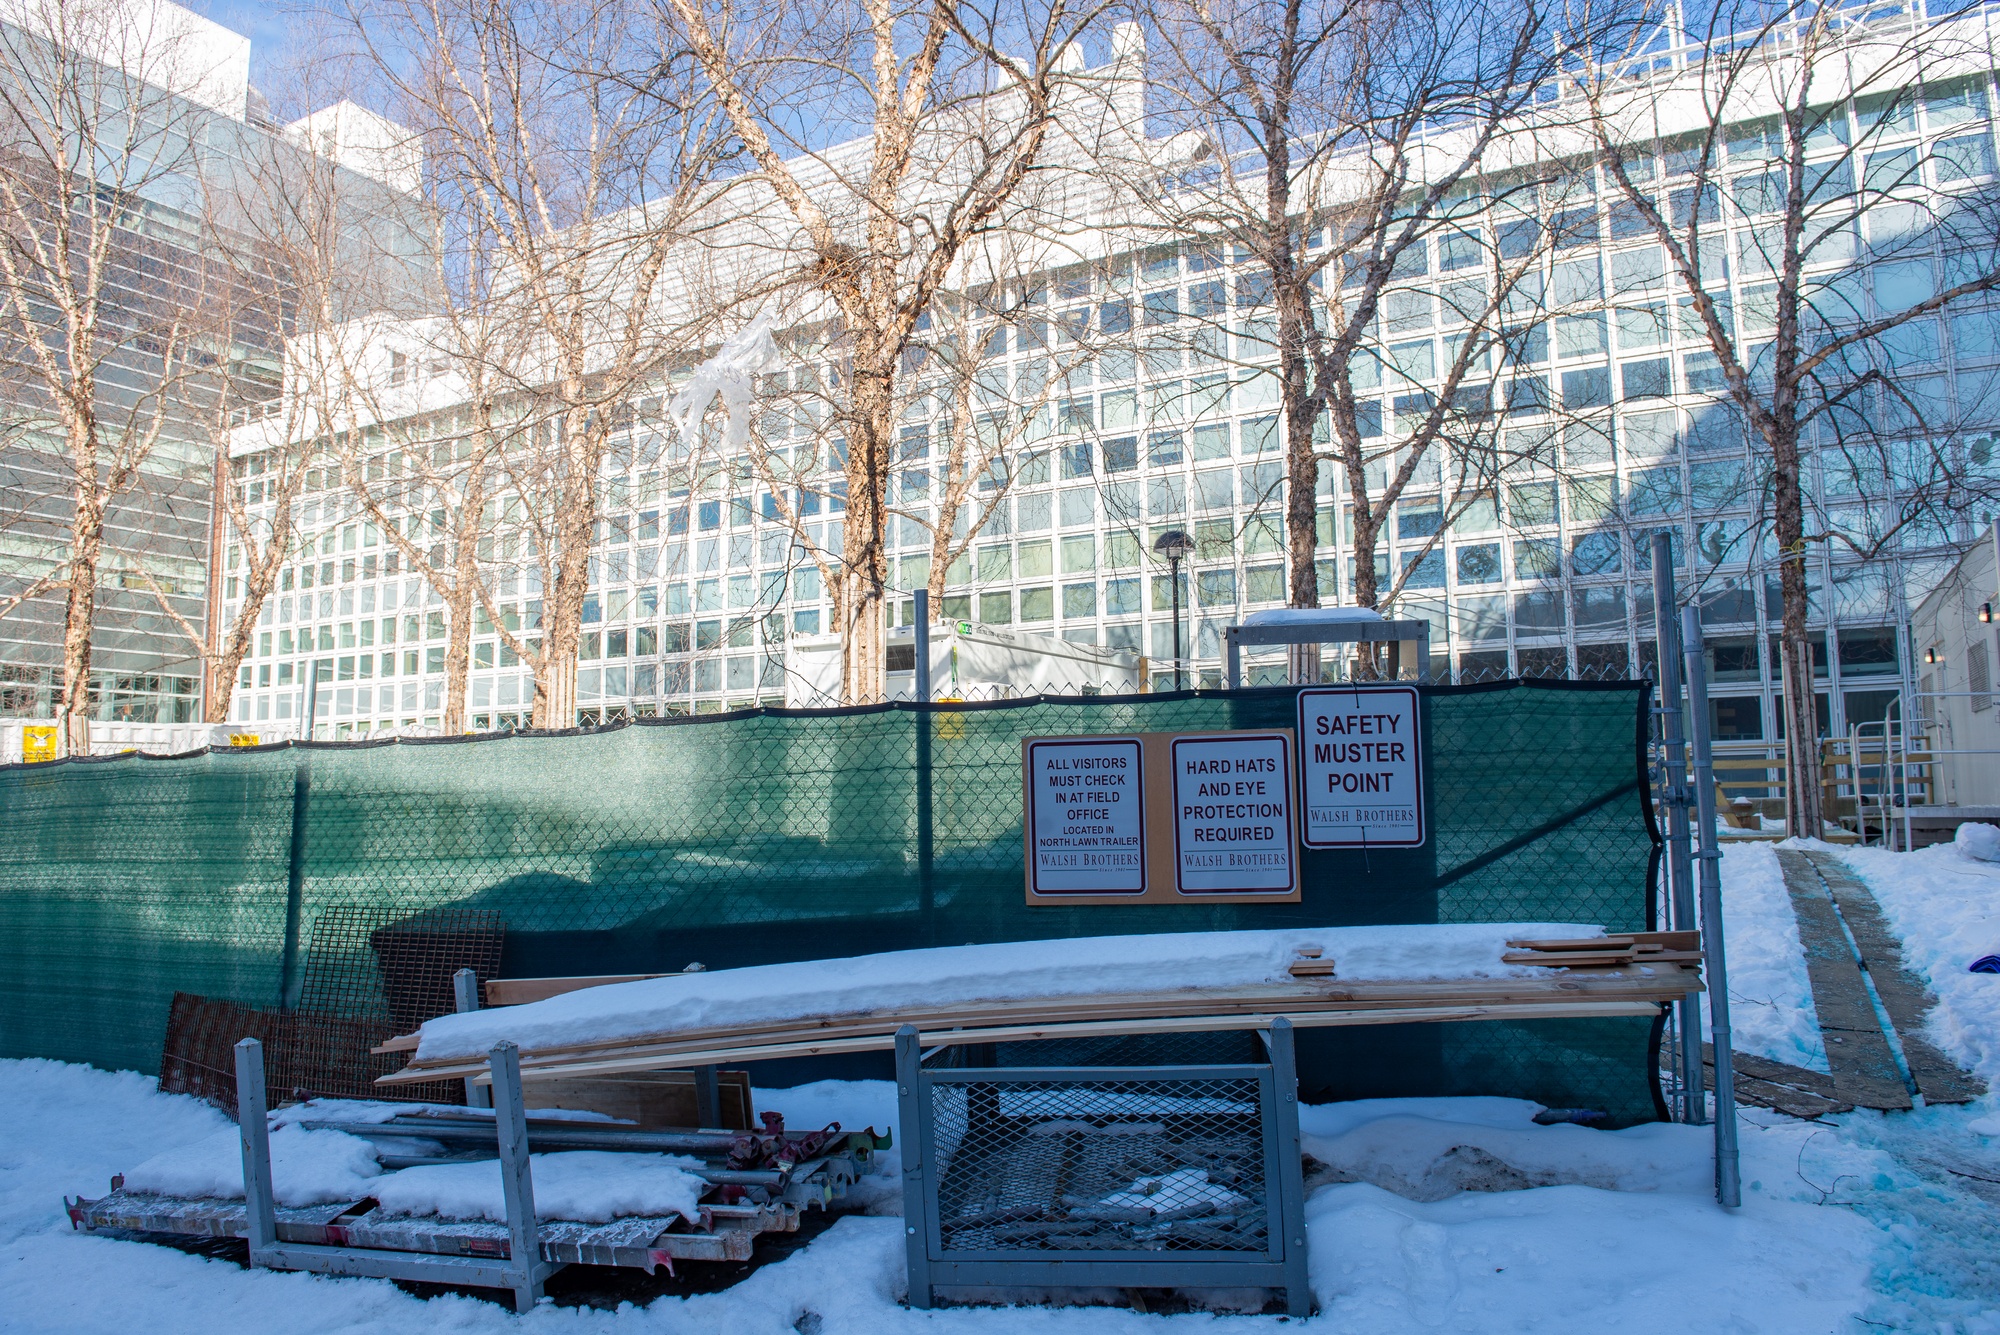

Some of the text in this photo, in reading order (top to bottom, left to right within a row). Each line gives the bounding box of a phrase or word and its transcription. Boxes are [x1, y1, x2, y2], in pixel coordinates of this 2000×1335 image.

[1316, 714, 1401, 736] SAFETY
[1314, 742, 1406, 764] MUSTER
[1046, 757, 1127, 770] ALL VISITORS
[1186, 758, 1276, 775] HARD HATS
[1049, 774, 1126, 787] MUST CHECK
[1328, 772, 1394, 793] POINT
[1198, 781, 1266, 797] AND EYE
[1055, 791, 1120, 803] IN AT FIELD
[1067, 808, 1109, 820] OFFICE
[1183, 803, 1283, 820] PROTECTION
[1310, 809, 1414, 822] WALSH BROTHERS
[1063, 825, 1114, 835] LOCATED IN
[1194, 826, 1274, 842] REQUIRED
[1040, 836, 1139, 847] NORTH LAWN TRAILER
[1040, 853, 1139, 866] WALSH BROTHERS
[1184, 853, 1286, 867] WALSH BROTHERS
